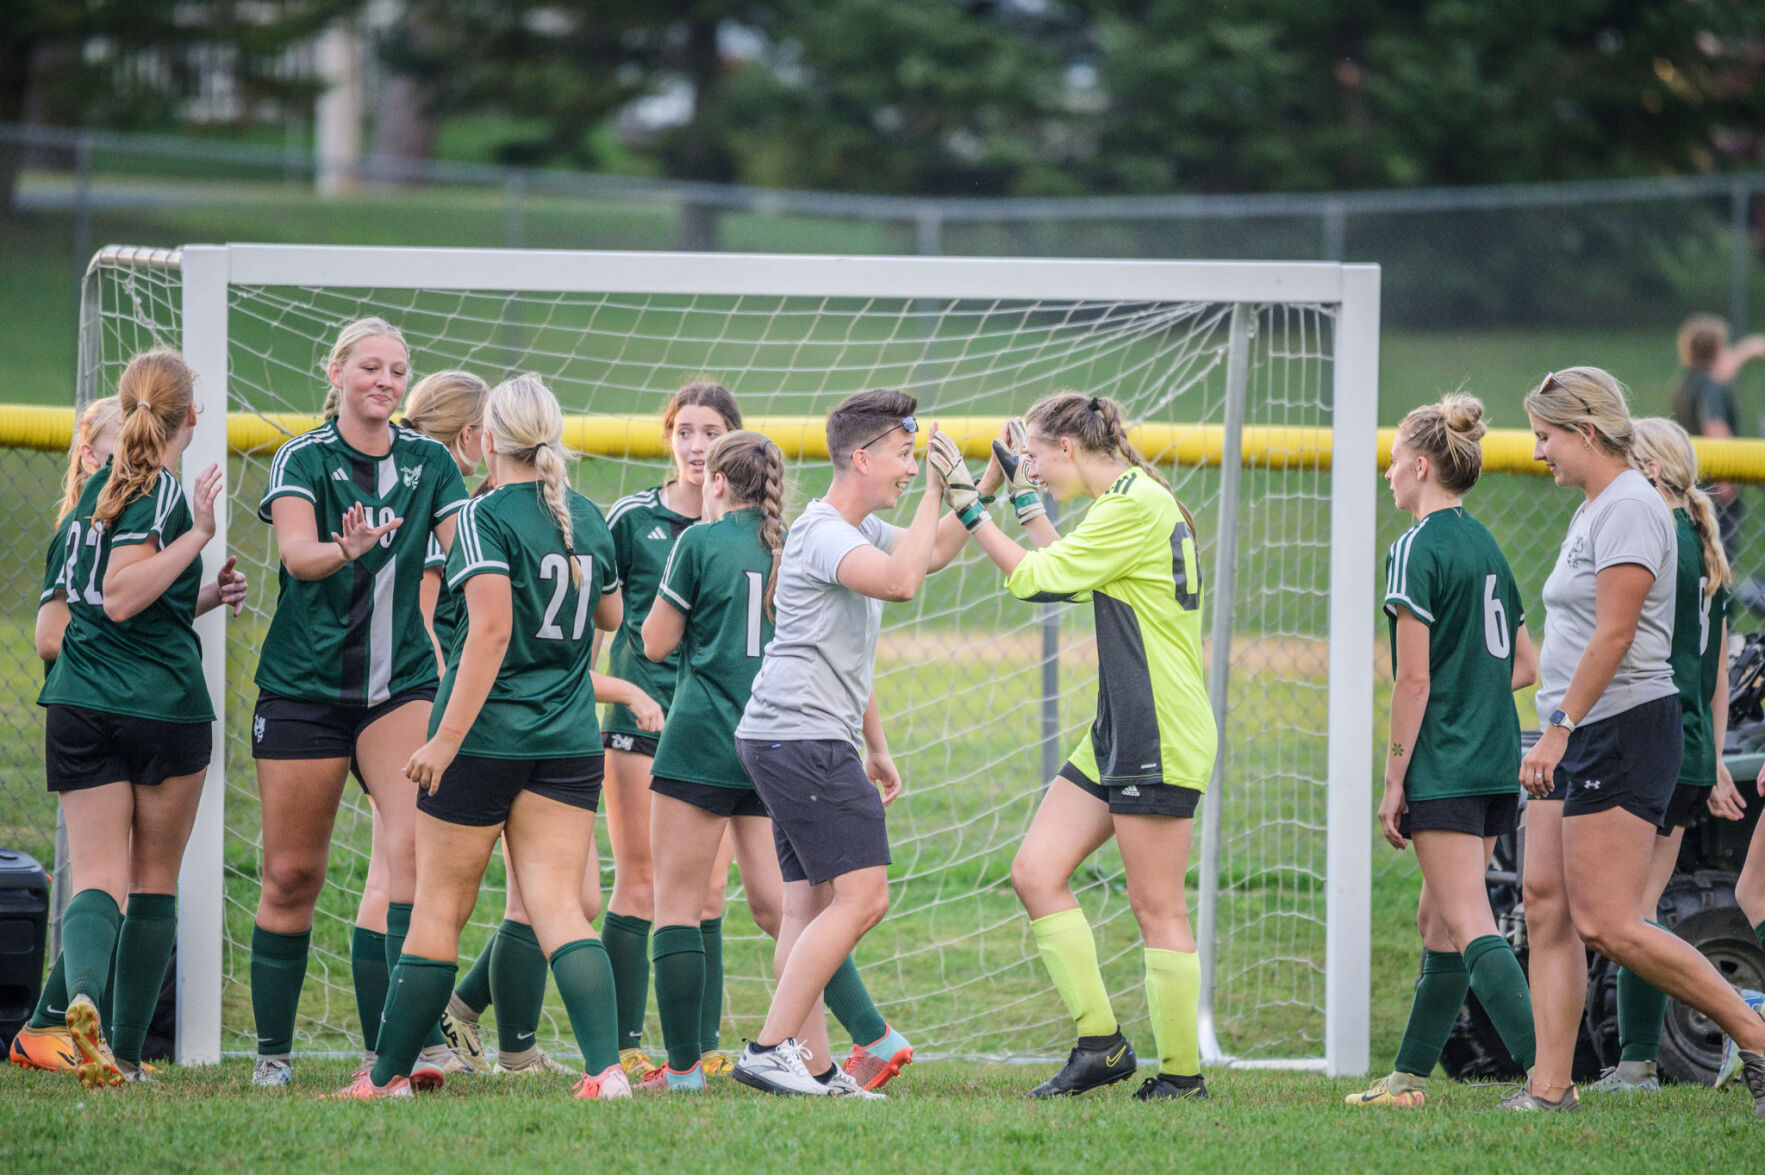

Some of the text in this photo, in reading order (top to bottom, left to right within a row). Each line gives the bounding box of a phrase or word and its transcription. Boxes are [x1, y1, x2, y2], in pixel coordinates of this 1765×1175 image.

[65, 520, 104, 605] 22
[535, 552, 593, 640] 21
[743, 570, 762, 657] 1
[1483, 573, 1510, 659] 6
